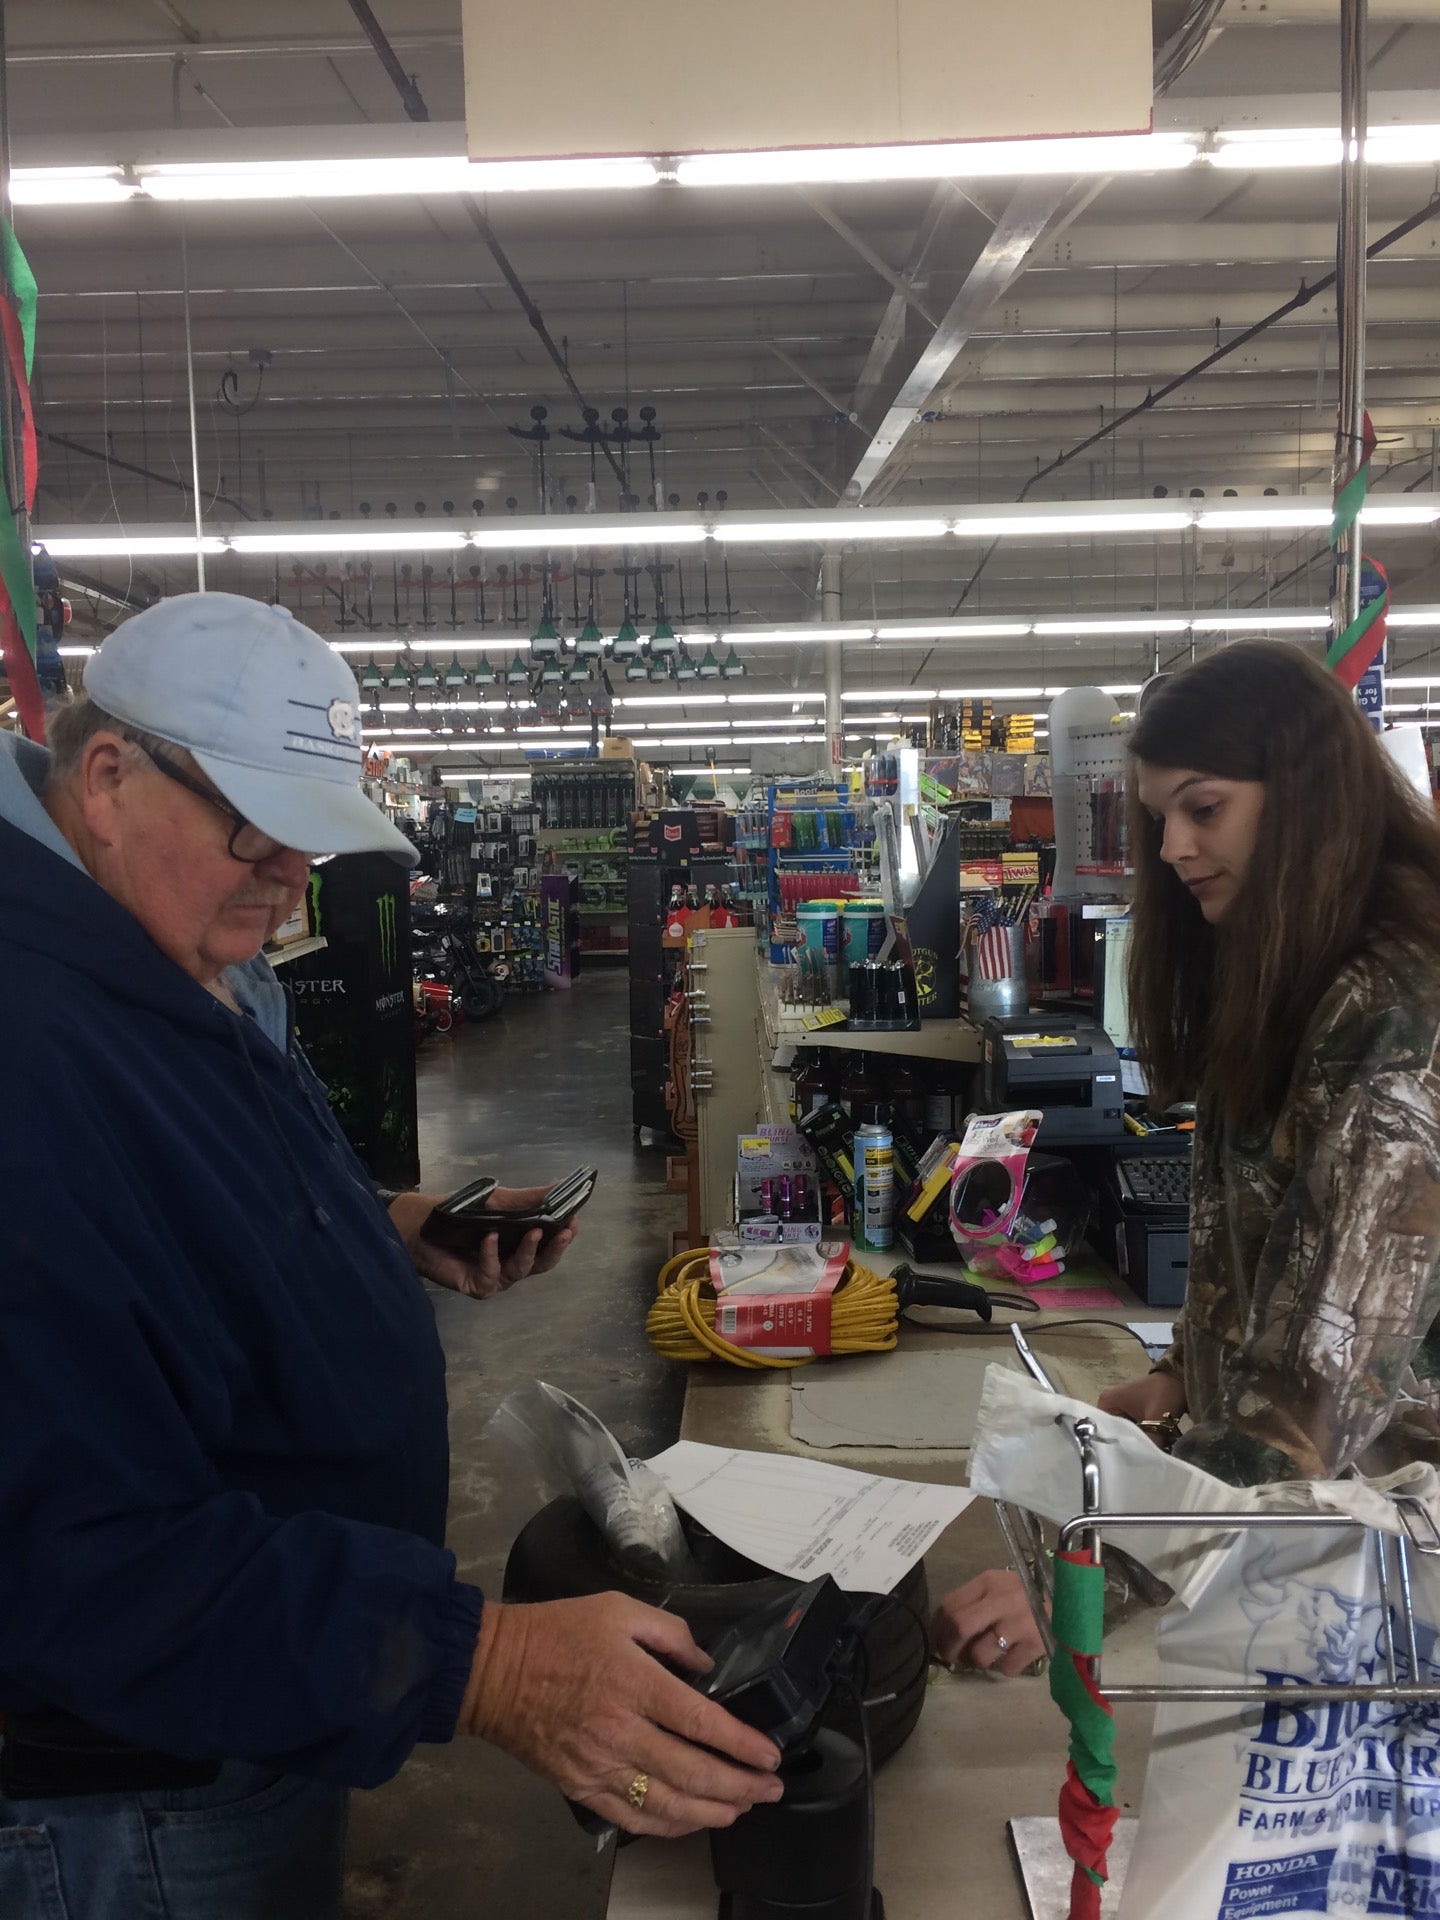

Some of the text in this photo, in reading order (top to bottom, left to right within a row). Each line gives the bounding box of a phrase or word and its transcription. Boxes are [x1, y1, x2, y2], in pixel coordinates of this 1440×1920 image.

[1002, 865, 1038, 880] TWIX
[1238, 1807, 1305, 1831] FARM
[1314, 1807, 1327, 1824] &
[1234, 1854, 1319, 1881] HONDA
[1228, 1883, 1275, 1902] Power
[1223, 1895, 1300, 1920] Equipment
